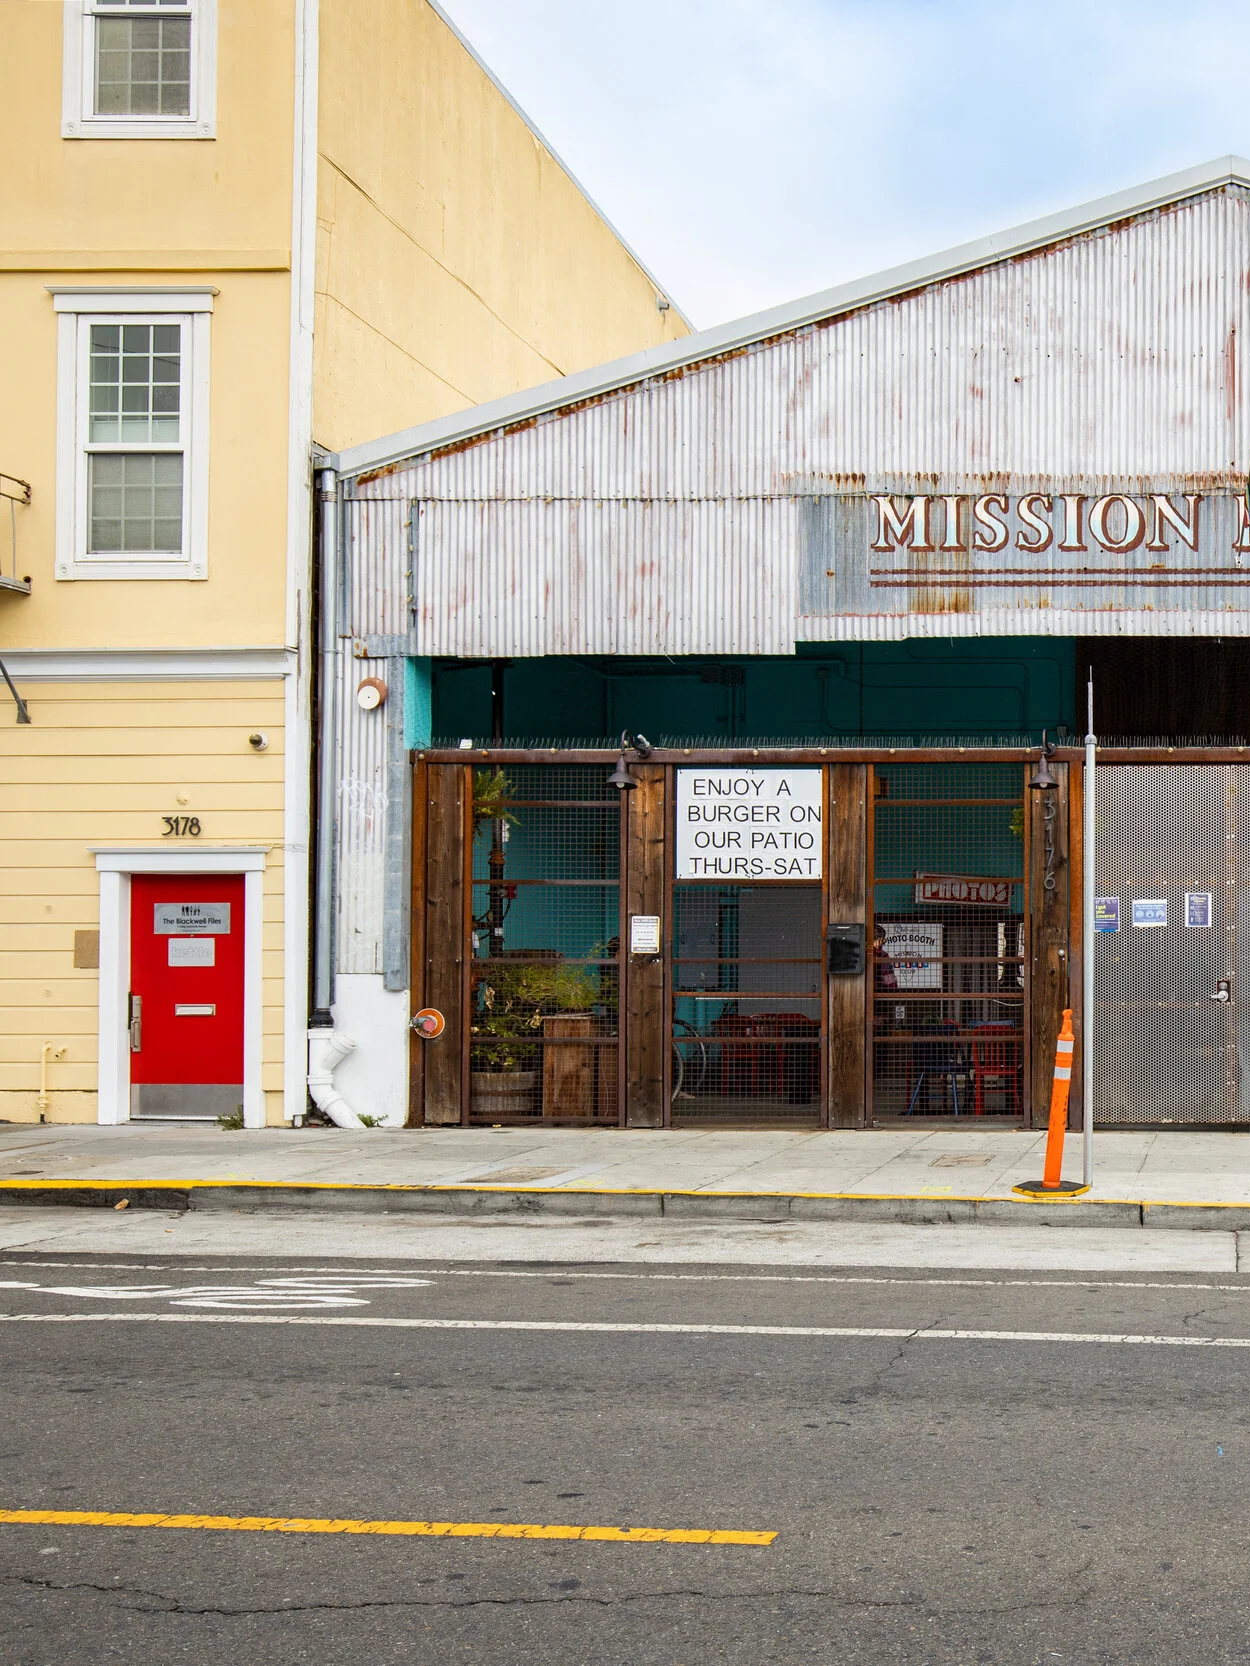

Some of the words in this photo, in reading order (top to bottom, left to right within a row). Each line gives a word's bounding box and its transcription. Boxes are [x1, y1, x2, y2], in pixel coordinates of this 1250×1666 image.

[870, 493, 1205, 554] MISSION
[693, 778, 765, 796] ENJOY
[776, 779, 792, 797] A
[688, 805, 781, 823] BURGER
[790, 805, 821, 823] ON
[161, 815, 202, 837] 3178
[694, 831, 742, 849] OUR
[751, 832, 814, 850] PATIO
[1044, 800, 1056, 890] 3176
[689, 857, 817, 875] THURS-SAT
[924, 881, 1007, 902] PHOTOS
[909, 934, 936, 946] BOOTH
